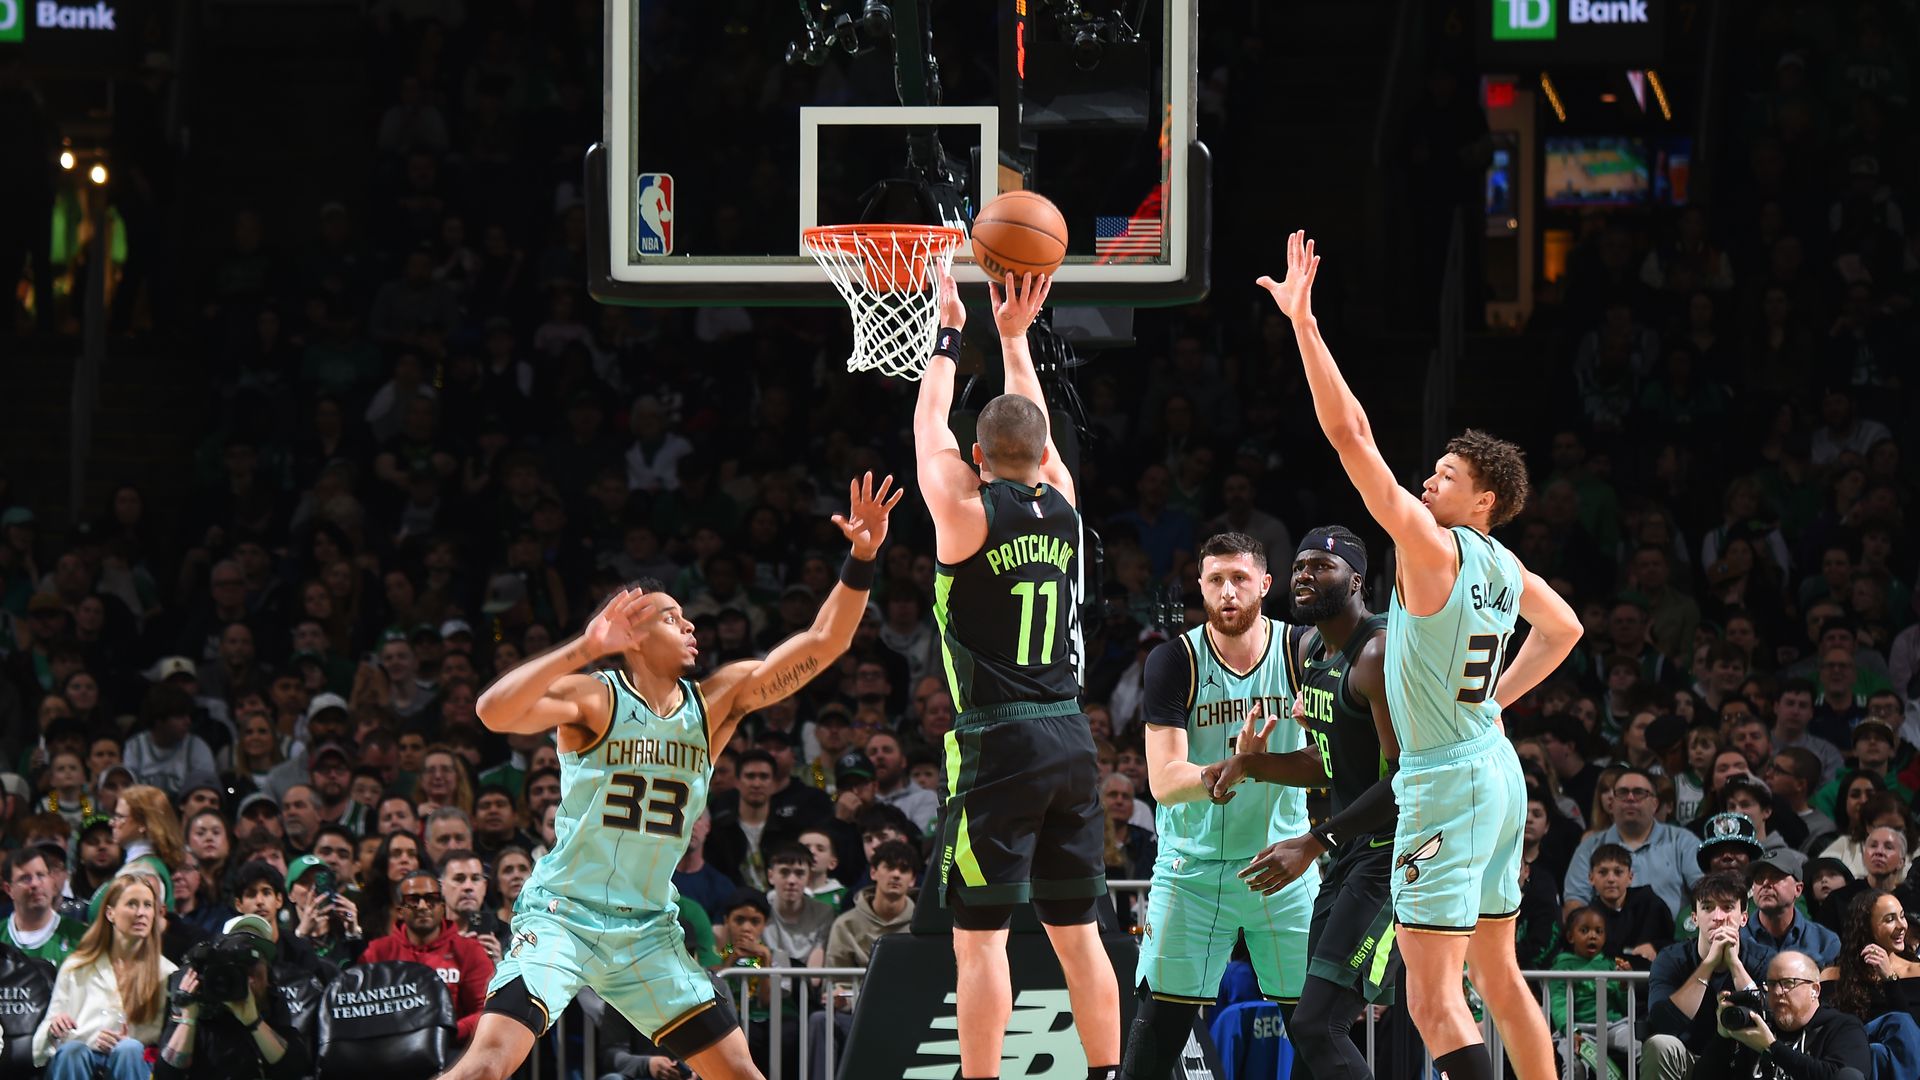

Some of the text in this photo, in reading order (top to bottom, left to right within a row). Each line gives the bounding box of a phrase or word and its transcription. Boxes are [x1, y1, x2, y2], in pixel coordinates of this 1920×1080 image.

[36, 0, 116, 30] Bank
[1502, 0, 1648, 29] TD Bank
[641, 237, 660, 251] NBA
[1010, 581, 1058, 666] 11
[1456, 633, 1509, 703] 31
[1301, 684, 1335, 724] ELTICS
[606, 738, 706, 774] CHARLOTTE
[602, 772, 690, 839] 33
[1350, 936, 1376, 969] BOSTON
[0, 986, 31, 1000] LIN
[336, 982, 418, 1006] FRANKLIN
